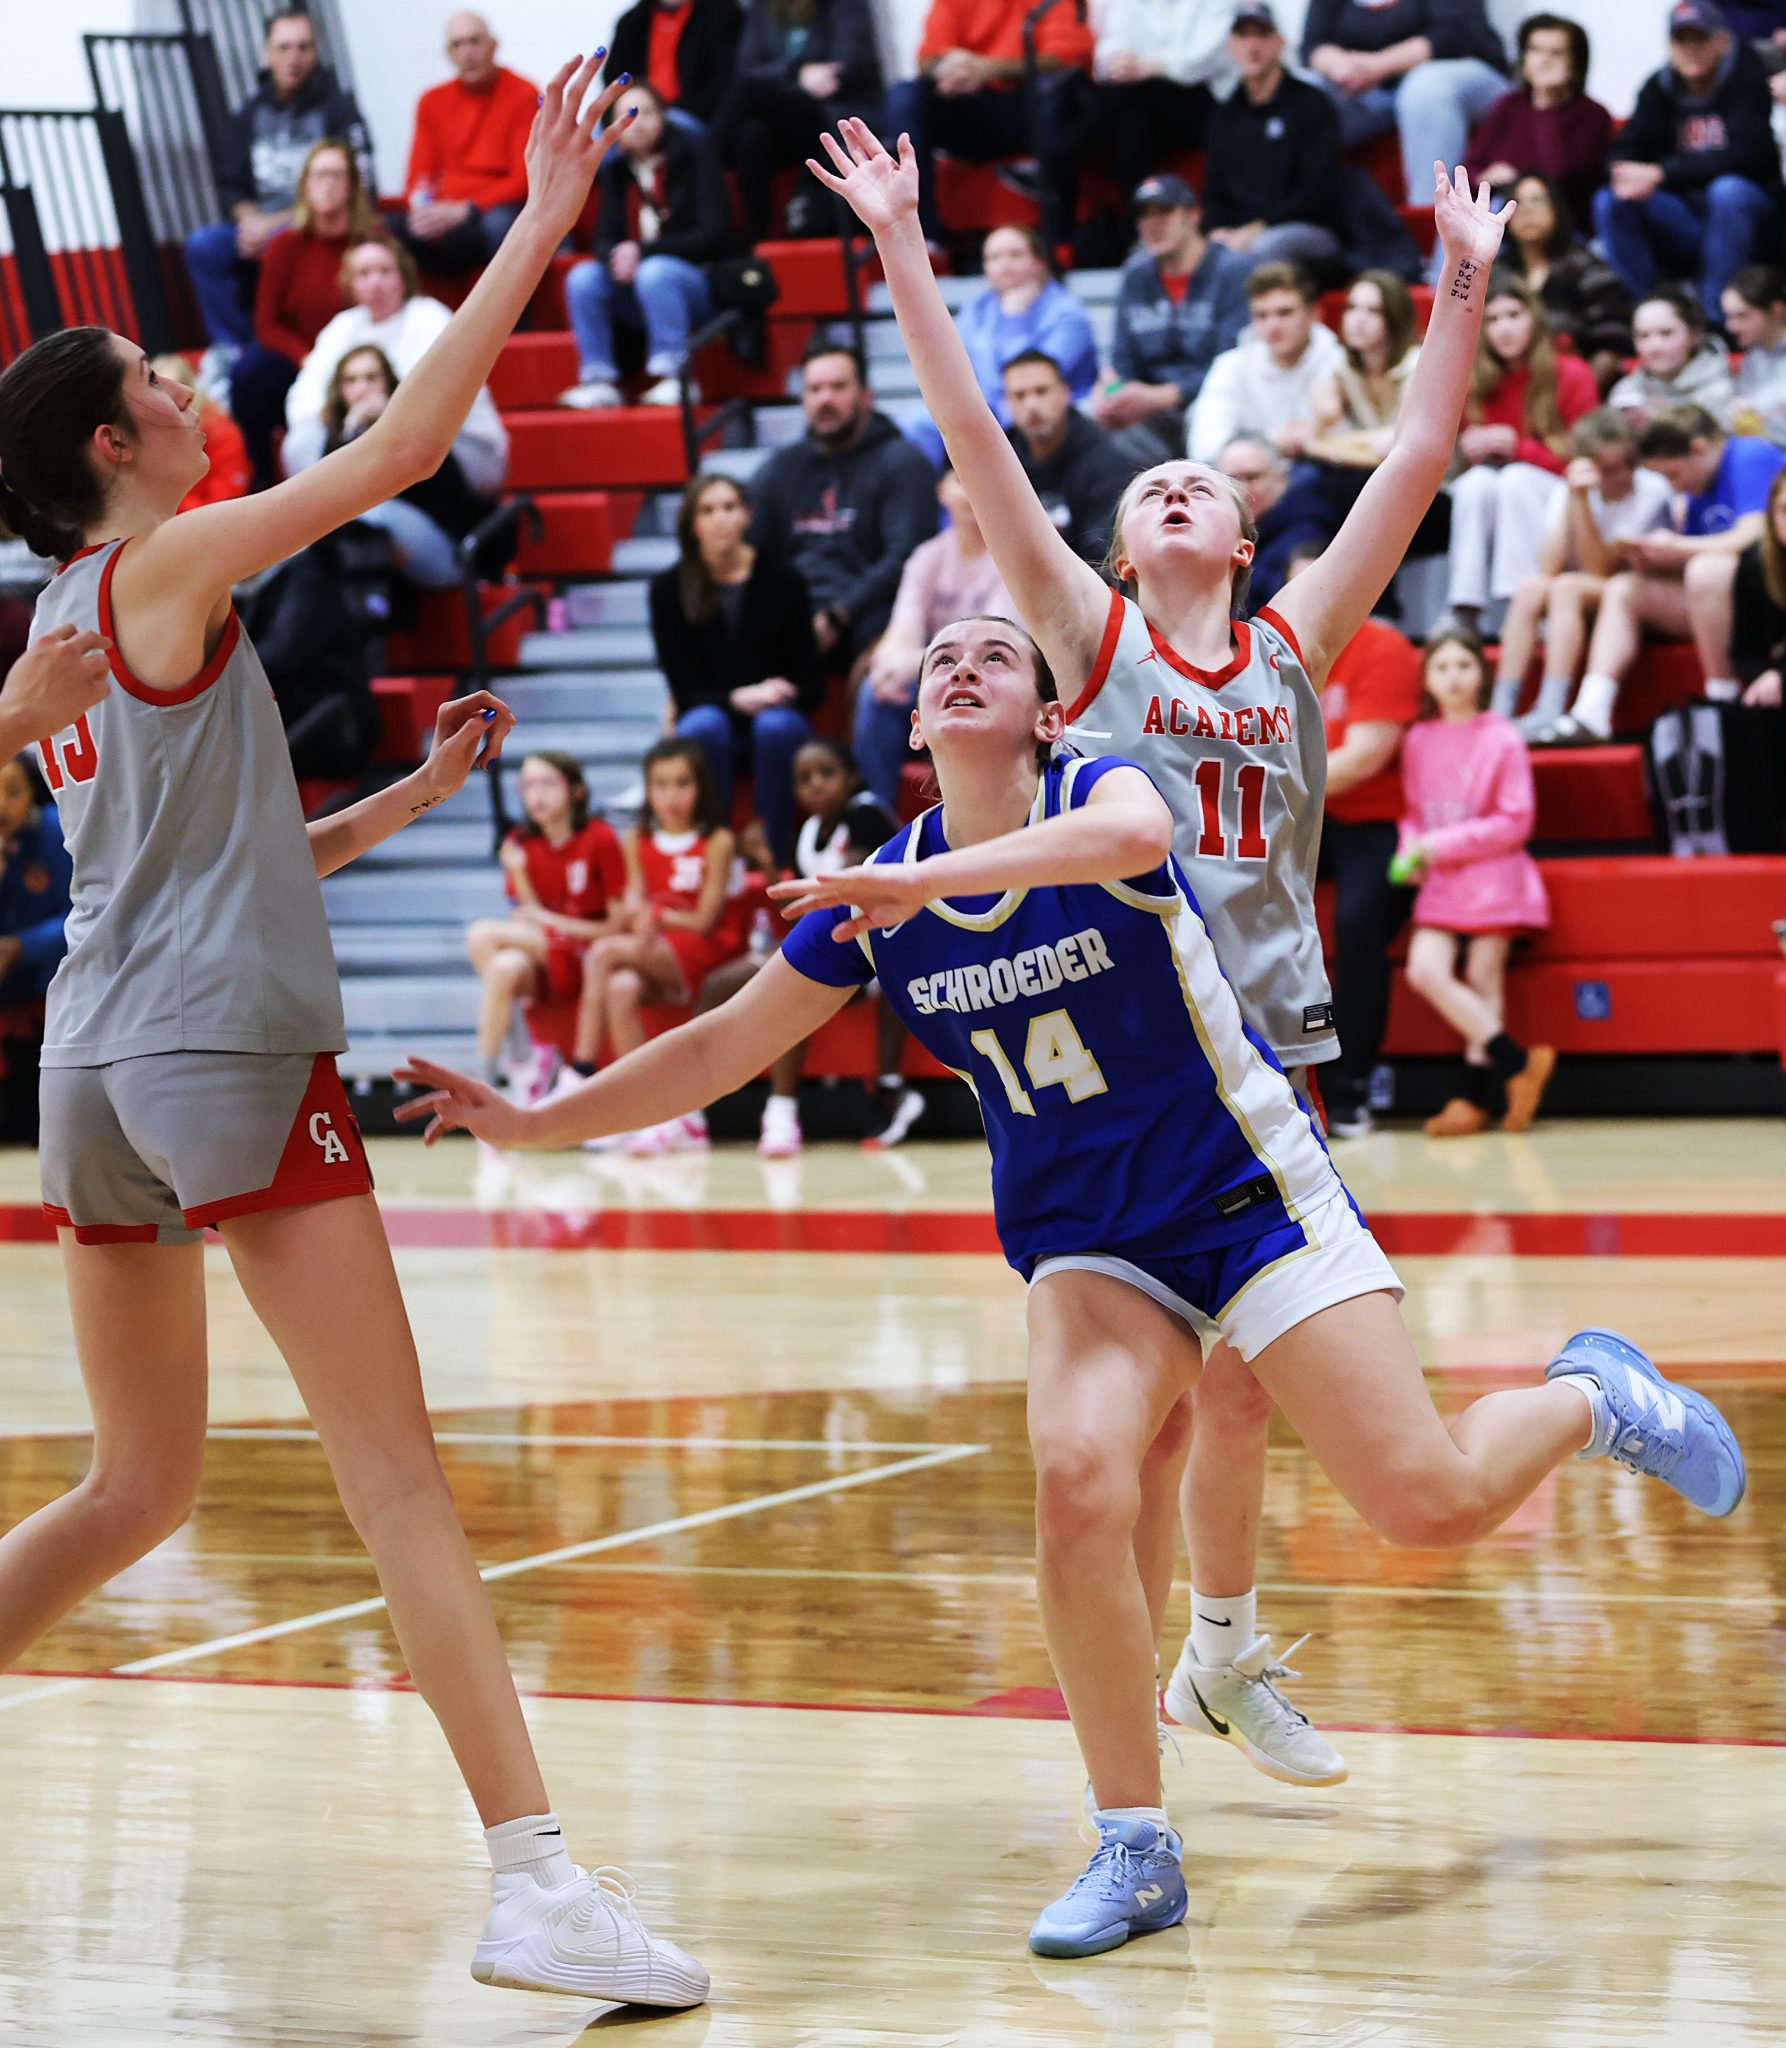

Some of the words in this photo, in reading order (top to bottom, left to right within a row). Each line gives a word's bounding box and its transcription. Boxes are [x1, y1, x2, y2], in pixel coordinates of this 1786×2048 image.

[1142, 694, 1293, 747] ACADEMY
[1191, 757, 1270, 862] 11
[906, 927, 1116, 1015] SCHROEDER
[970, 1007, 1109, 1117] 14
[309, 1111, 350, 1164] CA
[1255, 1186, 1266, 1195] L
[1134, 1883, 1164, 1909] N
